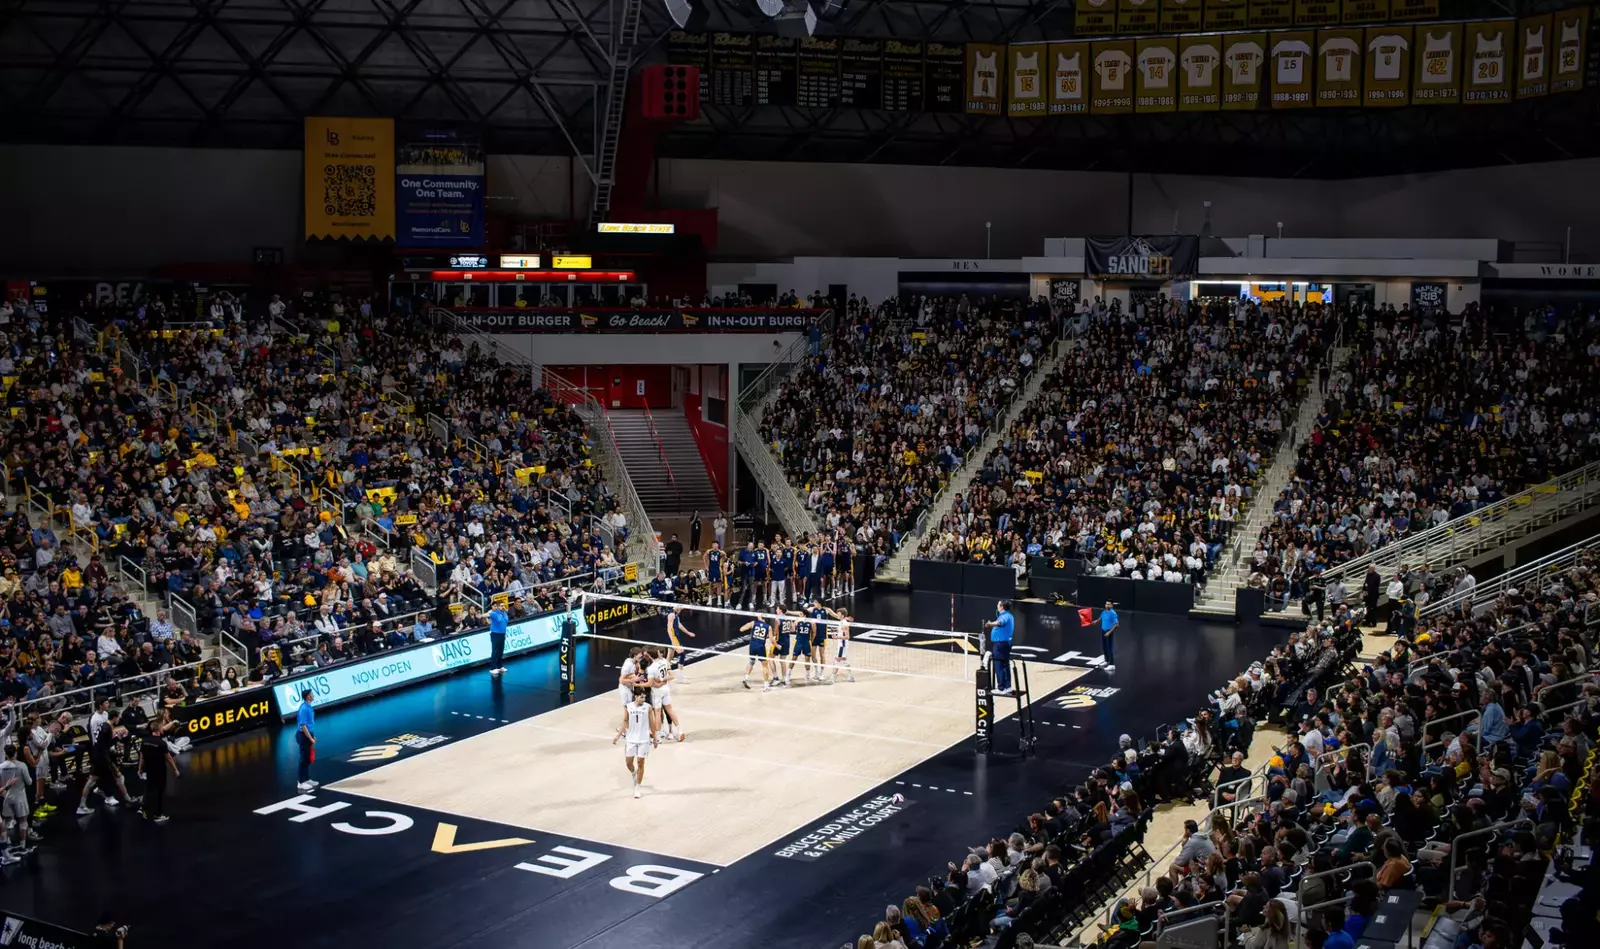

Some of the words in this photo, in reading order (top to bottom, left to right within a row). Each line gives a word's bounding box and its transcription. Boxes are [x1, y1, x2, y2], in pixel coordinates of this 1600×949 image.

[1196, 64, 1203, 77] 7
[1240, 61, 1248, 76] 2
[1283, 60, 1296, 70] 15
[1335, 57, 1343, 71] 7
[1427, 58, 1447, 75] 42
[1479, 62, 1498, 78] 20
[1149, 66, 1163, 80] 14
[401, 179, 421, 188] One
[423, 179, 480, 191] Community.
[416, 189, 436, 198] One
[437, 189, 465, 198] Team.
[622, 224, 647, 232] BEACH
[952, 261, 980, 270] MEN
[1108, 255, 1173, 274] SANDPIT
[1058, 287, 1073, 295] RIB
[1420, 292, 1438, 301] RIB
[458, 316, 514, 325] N-N-OUT
[518, 316, 571, 326] BURGER
[609, 316, 627, 327] Go
[629, 314, 671, 326] Beach!
[708, 316, 765, 326] IN-N-OUT
[1053, 559, 1065, 568] 29
[601, 603, 629, 623] BEACH
[753, 626, 766, 637] 23
[782, 621, 791, 630] 20
[799, 626, 809, 634] 12
[511, 634, 532, 649] Good
[438, 638, 472, 662] JAN'S
[352, 669, 380, 686] NOW
[381, 660, 412, 677] OPEN
[660, 667, 668, 678] 31
[188, 716, 211, 733] GO
[215, 701, 269, 727] BEACH
[636, 714, 639, 723] 1
[976, 688, 988, 737] BEACH
[774, 833, 826, 858] BRUCE
[835, 809, 869, 825] MAC
[862, 795, 893, 810] RAE
[803, 850, 823, 858] &
[814, 825, 865, 852] FAMILY
[858, 804, 902, 827] COURT
[17, 931, 38, 949] long
